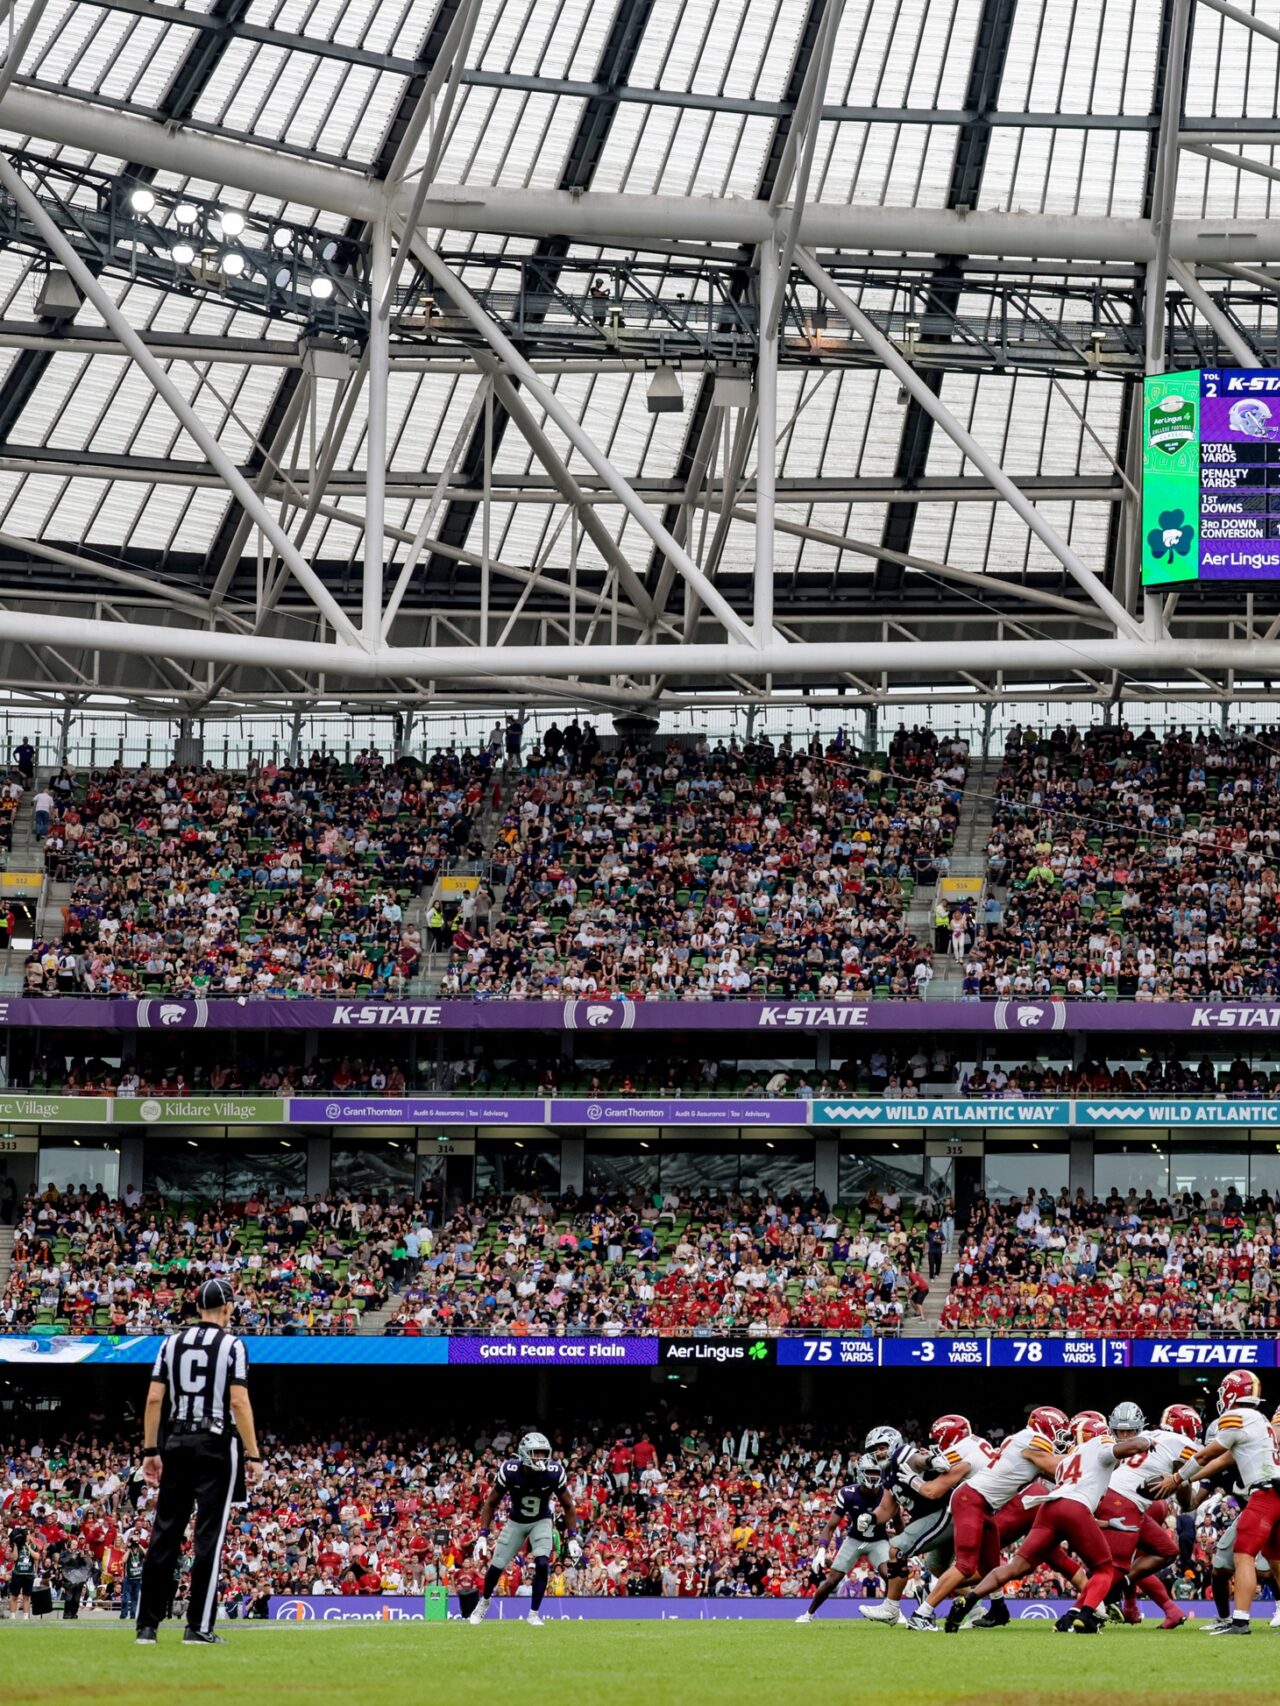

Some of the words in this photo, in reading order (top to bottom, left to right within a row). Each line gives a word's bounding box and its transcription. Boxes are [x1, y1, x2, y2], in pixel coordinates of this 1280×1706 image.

[1206, 384, 1217, 397] 2
[1201, 444, 1233, 453] TOTAL
[1202, 453, 1237, 463] YARDS
[1202, 469, 1249, 479] PENALTY
[1202, 478, 1237, 488] YARDS
[1202, 494, 1218, 504] 1ST
[1201, 503, 1243, 513] DOWNS
[1201, 519, 1220, 529] 3RD
[1221, 519, 1257, 529] DOWN
[1201, 529, 1264, 538] CONVERSION
[1202, 553, 1229, 566] Aer
[1231, 552, 1280, 569] Lingus
[332, 1006, 442, 1025] K-STATE
[759, 1007, 868, 1025] K-STATE
[16, 1101, 59, 1118] Village
[165, 1103, 211, 1117] Kildare
[213, 1103, 256, 1119] Village
[886, 1106, 929, 1120] WILD
[932, 1106, 1014, 1120] ATLANTIC
[1017, 1107, 1056, 1120] WAY
[1148, 1107, 1192, 1120] WILD
[1194, 1107, 1277, 1120] ATLANTIC
[438, 1145, 455, 1153] 314
[946, 1146, 963, 1155] 315
[803, 1341, 833, 1361] 75
[841, 1342, 872, 1351] TOTAL
[952, 1342, 978, 1352] PASS
[1065, 1343, 1094, 1352] RUSH
[1110, 1342, 1128, 1350] TOL
[667, 1345, 693, 1357] Aer
[696, 1345, 744, 1361] Lingus
[840, 1352, 874, 1362] YARDS
[911, 1342, 935, 1362] -3
[1013, 1342, 1043, 1362] 78
[1150, 1345, 1258, 1363] K-STATE
[948, 1353, 982, 1363] YARDS
[1062, 1353, 1096, 1363] YARDS
[1114, 1352, 1123, 1364] 2
[180, 1349, 209, 1393] C
[520, 1495, 541, 1517] 9
